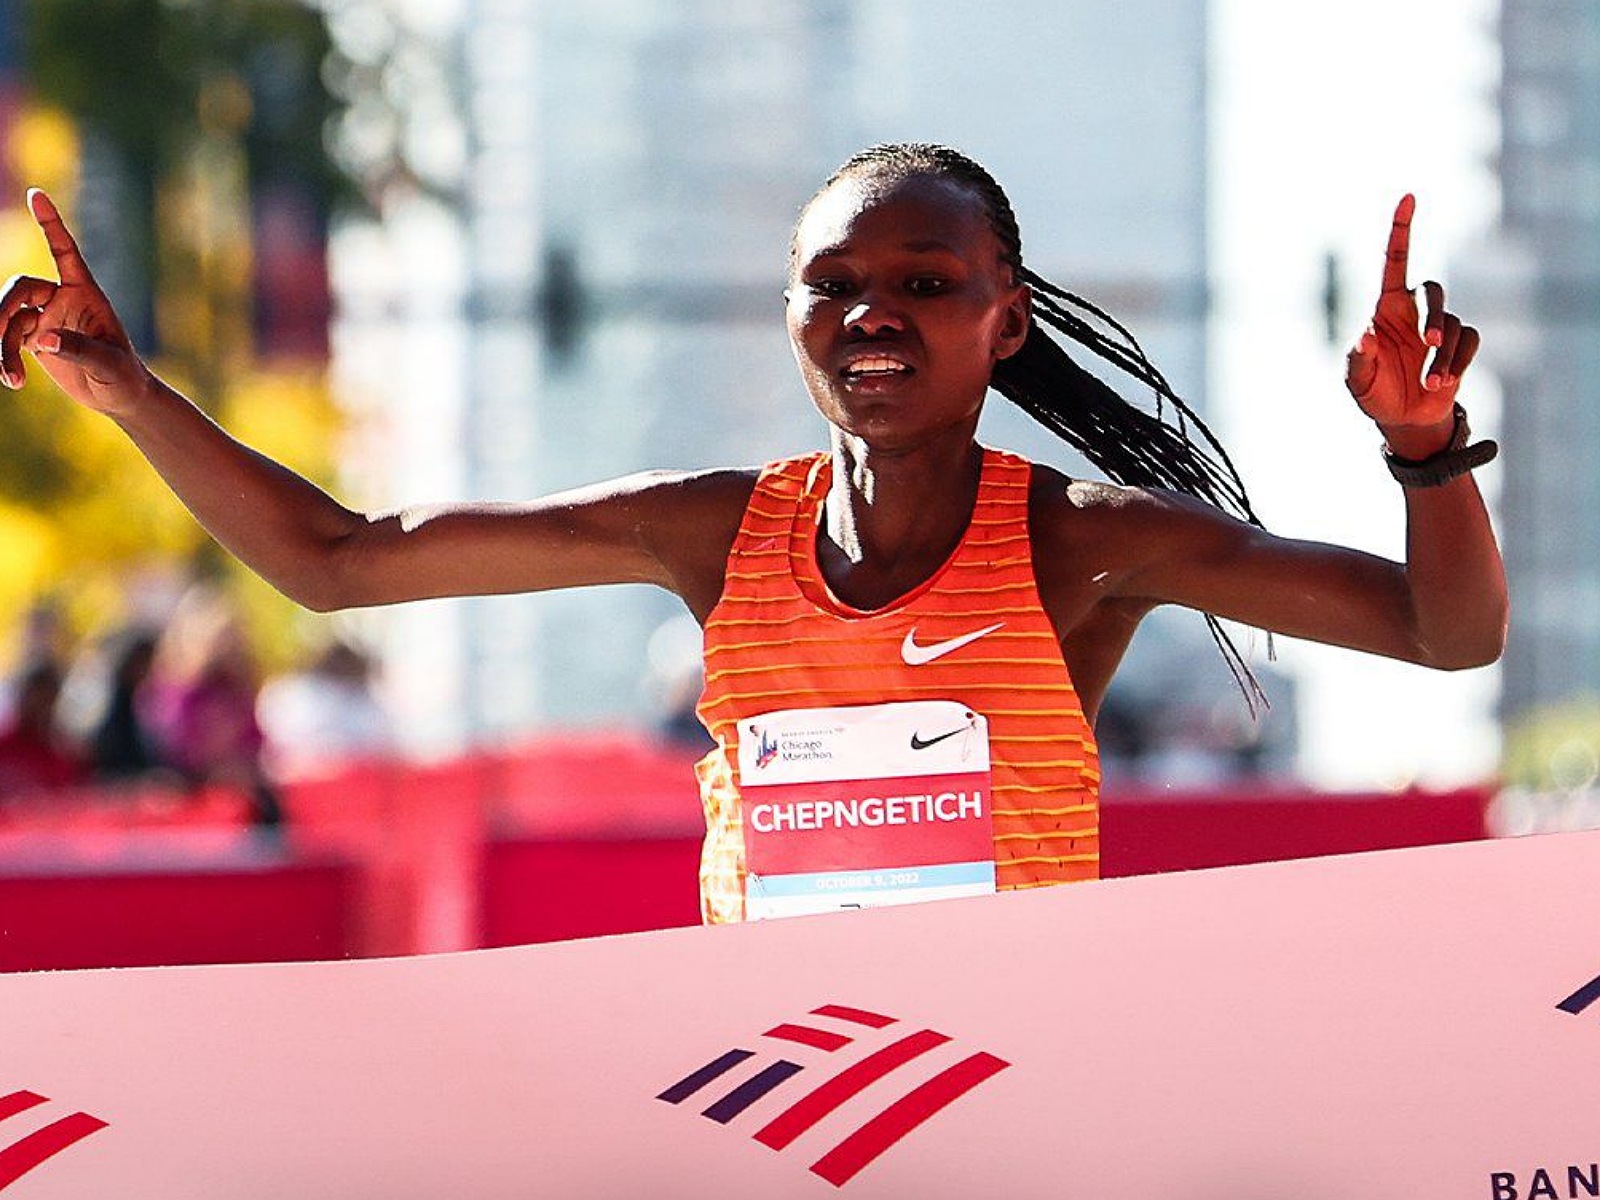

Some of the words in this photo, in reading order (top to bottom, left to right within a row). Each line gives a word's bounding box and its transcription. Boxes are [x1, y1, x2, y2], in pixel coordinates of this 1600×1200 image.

[781, 740, 822, 751] Chicago
[782, 751, 832, 761] Marathon
[751, 791, 982, 832] CHEPNGETICH
[816, 876, 872, 890] OCTOBER
[890, 872, 920, 885] 2022
